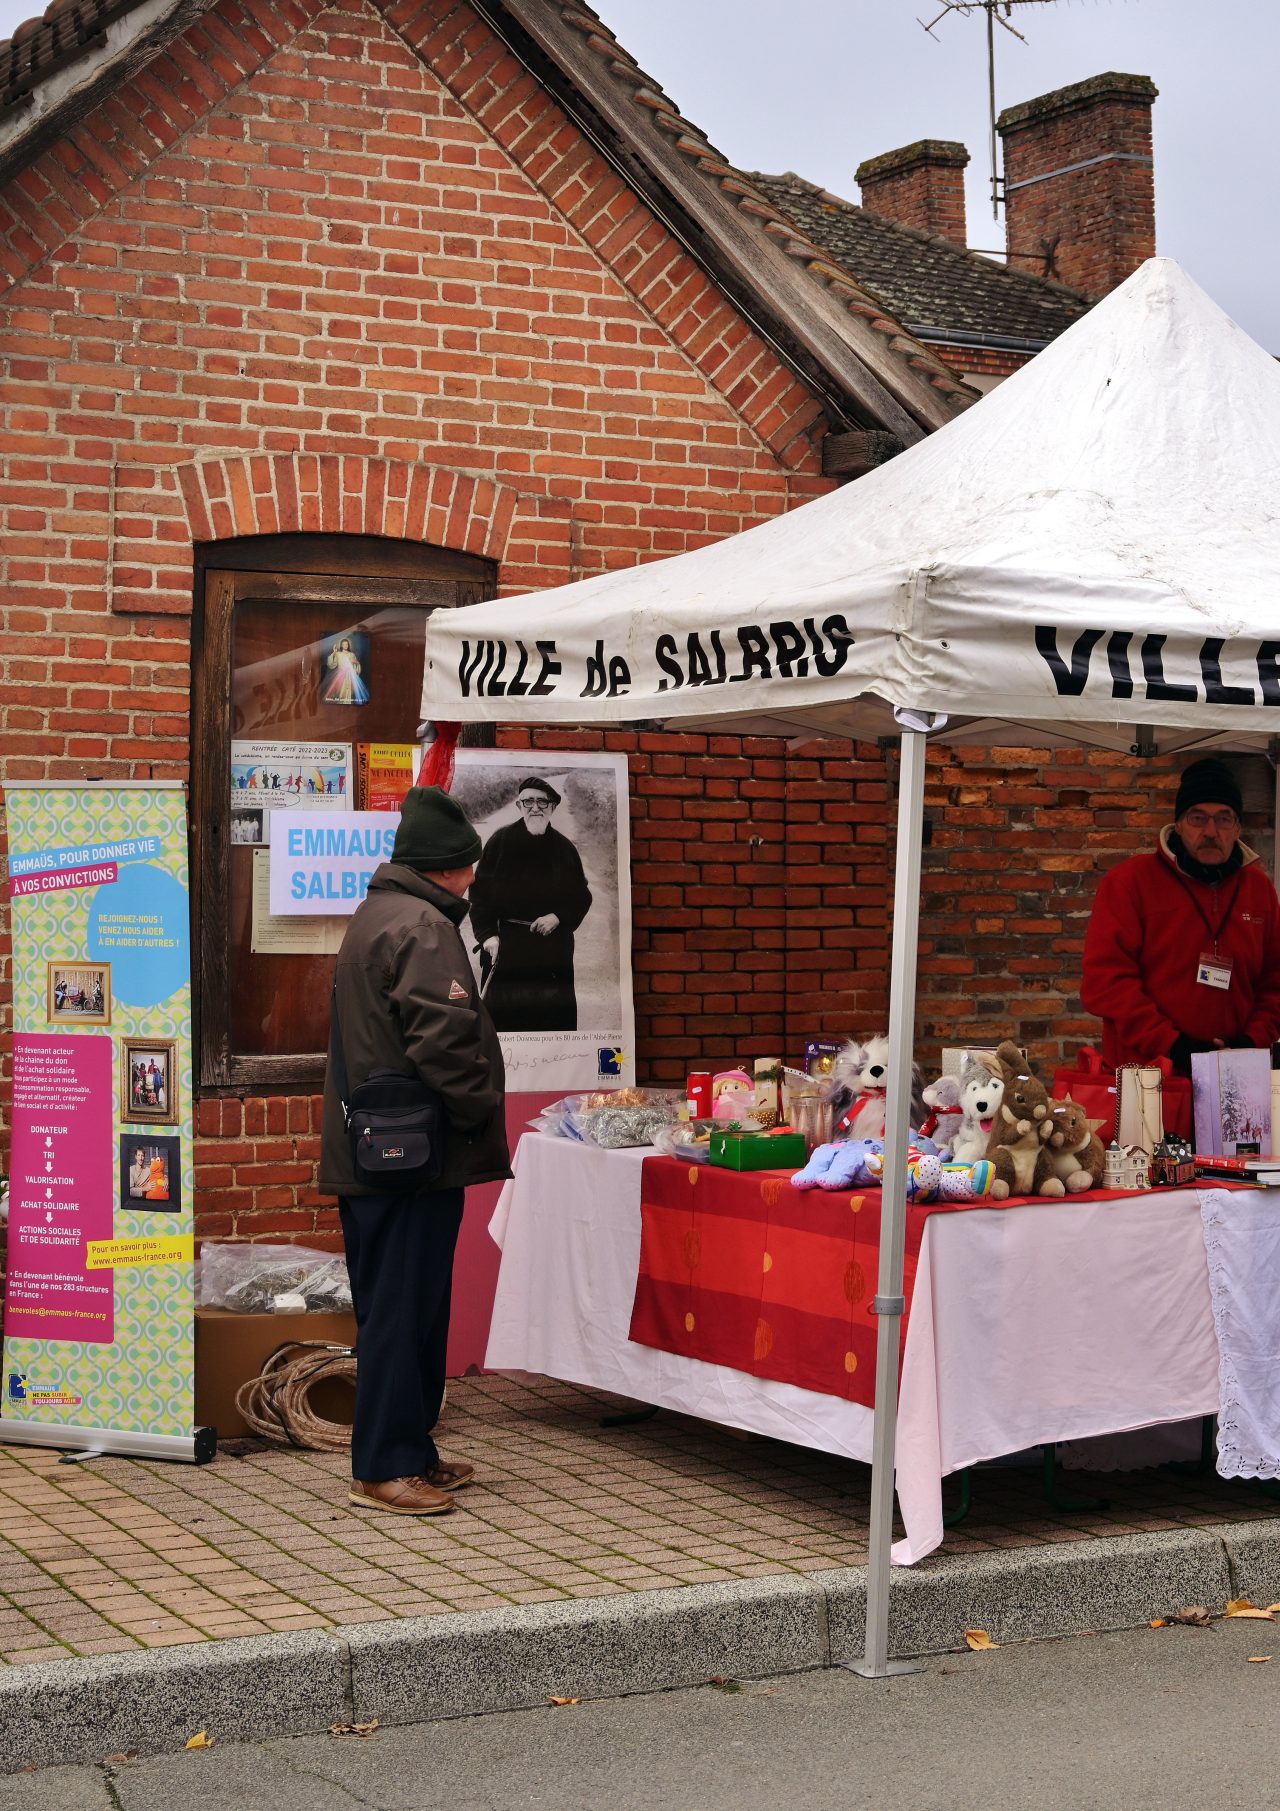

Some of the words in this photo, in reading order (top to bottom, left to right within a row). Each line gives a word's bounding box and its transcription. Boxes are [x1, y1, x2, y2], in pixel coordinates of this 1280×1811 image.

[459, 640, 562, 697] VILLE
[580, 640, 631, 698] de
[359, 752, 367, 811] PROPOSITIONS
[288, 828, 397, 857] EMMAUS
[12, 853, 57, 873] EMMAÜS,
[59, 851, 89, 865] POUR
[92, 843, 135, 860] DONNER
[137, 839, 155, 853] VIE
[14, 879, 20, 894] À
[21, 879, 40, 892] VOS
[42, 868, 114, 888] CONVICTIONS
[291, 871, 374, 900] SALBR
[98, 914, 158, 923] REJOIGNEZ-NOUS
[98, 926, 121, 934] VENEZ
[122, 926, 141, 935] NOUS
[141, 927, 164, 936] AIDER
[104, 938, 115, 946] EN
[116, 938, 137, 947] AIDER
[137, 938, 174, 948] D'AUTRES
[516, 1034, 540, 1042] Doisneau
[541, 1036, 553, 1044] pour
[24, 1046, 51, 1054] devenant
[52, 1047, 75, 1055] acteur
[55, 1057, 68, 1065] don
[25, 1065, 45, 1073] l'achat
[46, 1066, 75, 1075] solidaire
[55, 1086, 91, 1094] responsable,
[62, 1094, 87, 1102] créateur
[30, 1125, 68, 1134] DONATEUR
[43, 1151, 55, 1159] TRI
[25, 1175, 74, 1185] VALORISATION
[20, 1200, 42, 1209] ACHAT
[43, 1202, 80, 1211] SOLIDAIRE
[19, 1225, 47, 1234] ACTIONS
[48, 1227, 81, 1236] SOCIALES
[20, 1235, 28, 1243] ET
[29, 1235, 38, 1244] DE
[39, 1236, 80, 1246] SOLIDARITÉ
[91, 1246, 108, 1254] Pour
[120, 1243, 141, 1252] savoir
[142, 1242, 157, 1250] plus
[92, 1251, 182, 1265] www.emmaus-france.org
[14, 1270, 22, 1278] En
[23, 1271, 53, 1280] devenant
[54, 1272, 84, 1282] bénévole
[23, 1281, 40, 1289] l'une
[40, 1282, 49, 1290] de
[76, 1284, 109, 1294] structures
[17, 1290, 39, 1299] France
[9, 1305, 106, 1320] benevoles@emmaus-france.org
